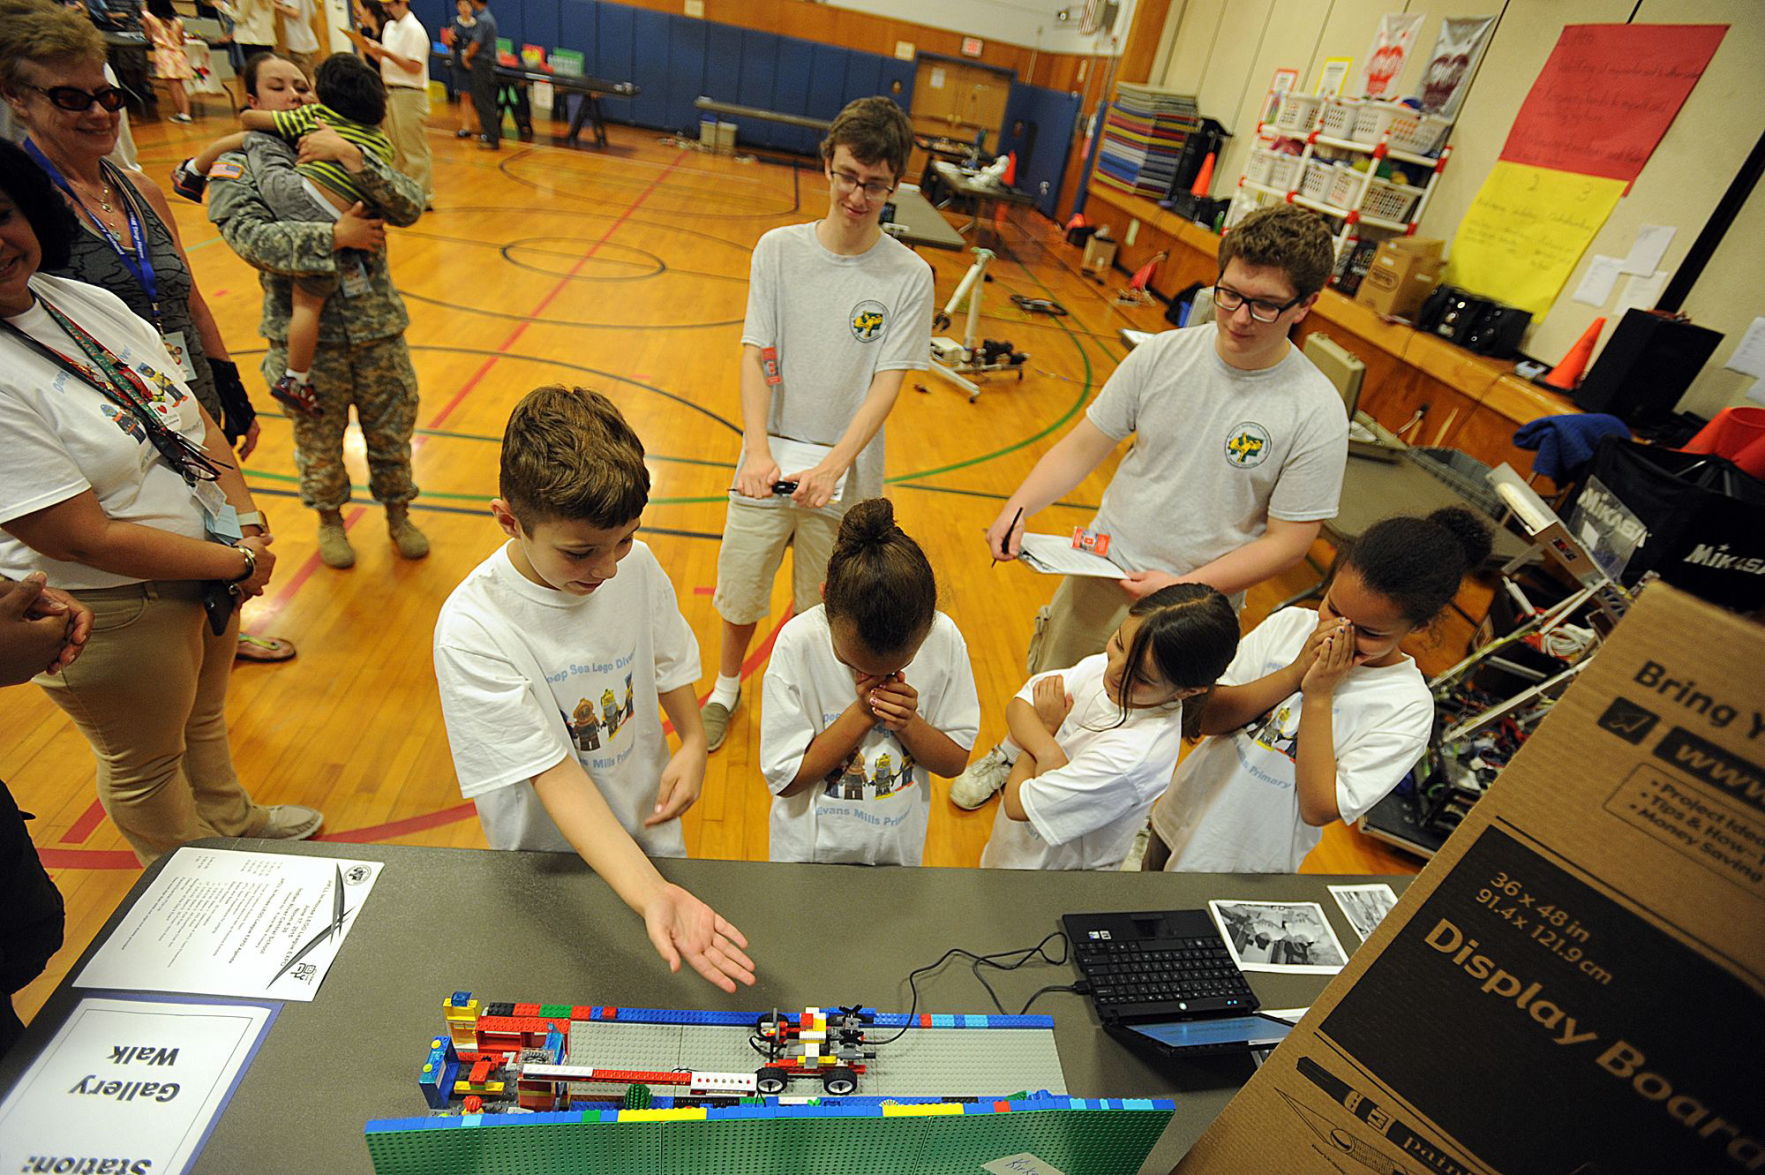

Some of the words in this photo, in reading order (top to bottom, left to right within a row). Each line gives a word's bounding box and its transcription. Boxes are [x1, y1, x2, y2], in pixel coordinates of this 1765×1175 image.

[570, 664, 590, 675] Sea
[592, 663, 614, 674] Lego
[1632, 660, 1738, 728] Bring
[1249, 765, 1292, 790] Primary
[816, 806, 850, 816] Evans
[854, 808, 880, 825] Mills
[1652, 795, 1685, 821] Tips
[1686, 817, 1700, 828] &
[1661, 784, 1725, 822] Project
[1638, 808, 1698, 845] Money
[1700, 842, 1763, 883] Saving
[1490, 872, 1522, 896] 36
[1518, 894, 1536, 908] x
[1536, 904, 1569, 928] 48
[1566, 921, 1590, 943] in
[1476, 888, 1517, 920] 91.4
[1531, 925, 1583, 962] 121.9
[1580, 960, 1613, 985] cm
[1424, 918, 1598, 1046] Display
[106, 1045, 180, 1066] Walk
[68, 1074, 180, 1103] Gallery
[22, 1156, 152, 1175] Station:
